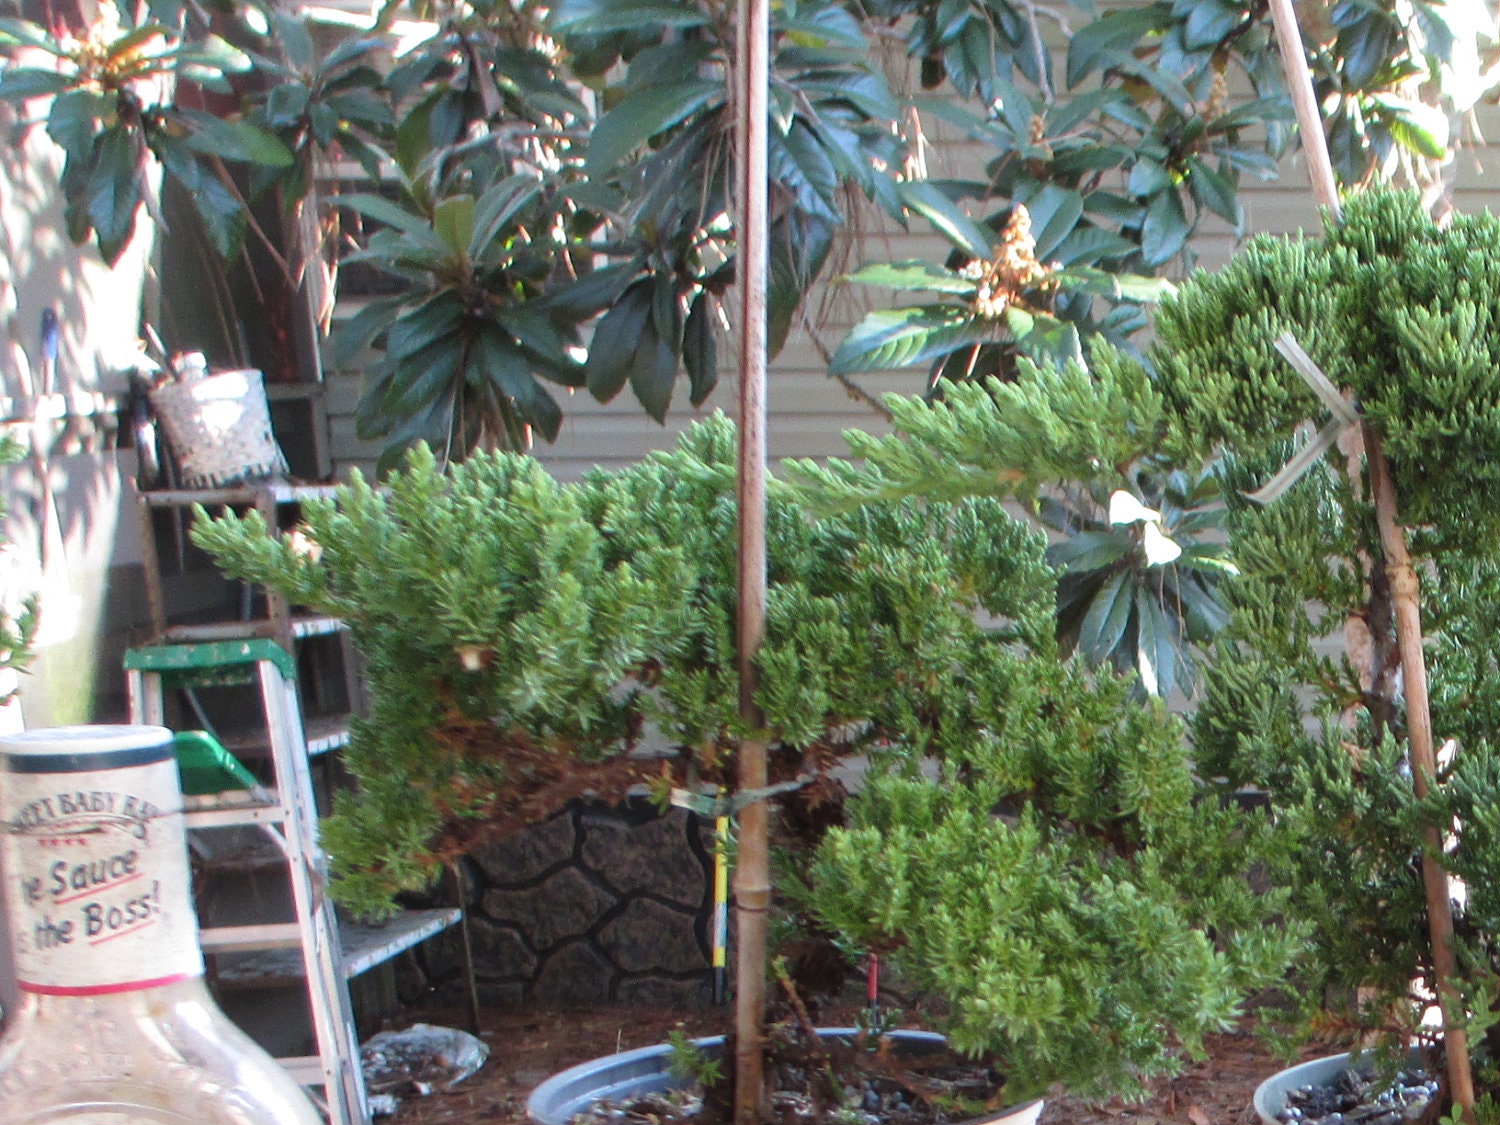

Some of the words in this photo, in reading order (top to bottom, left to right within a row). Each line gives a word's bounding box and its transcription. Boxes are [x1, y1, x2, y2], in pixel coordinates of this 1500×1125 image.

[57, 791, 118, 815] BABY
[50, 850, 137, 895] Sauce
[81, 879, 161, 937] Boss!
